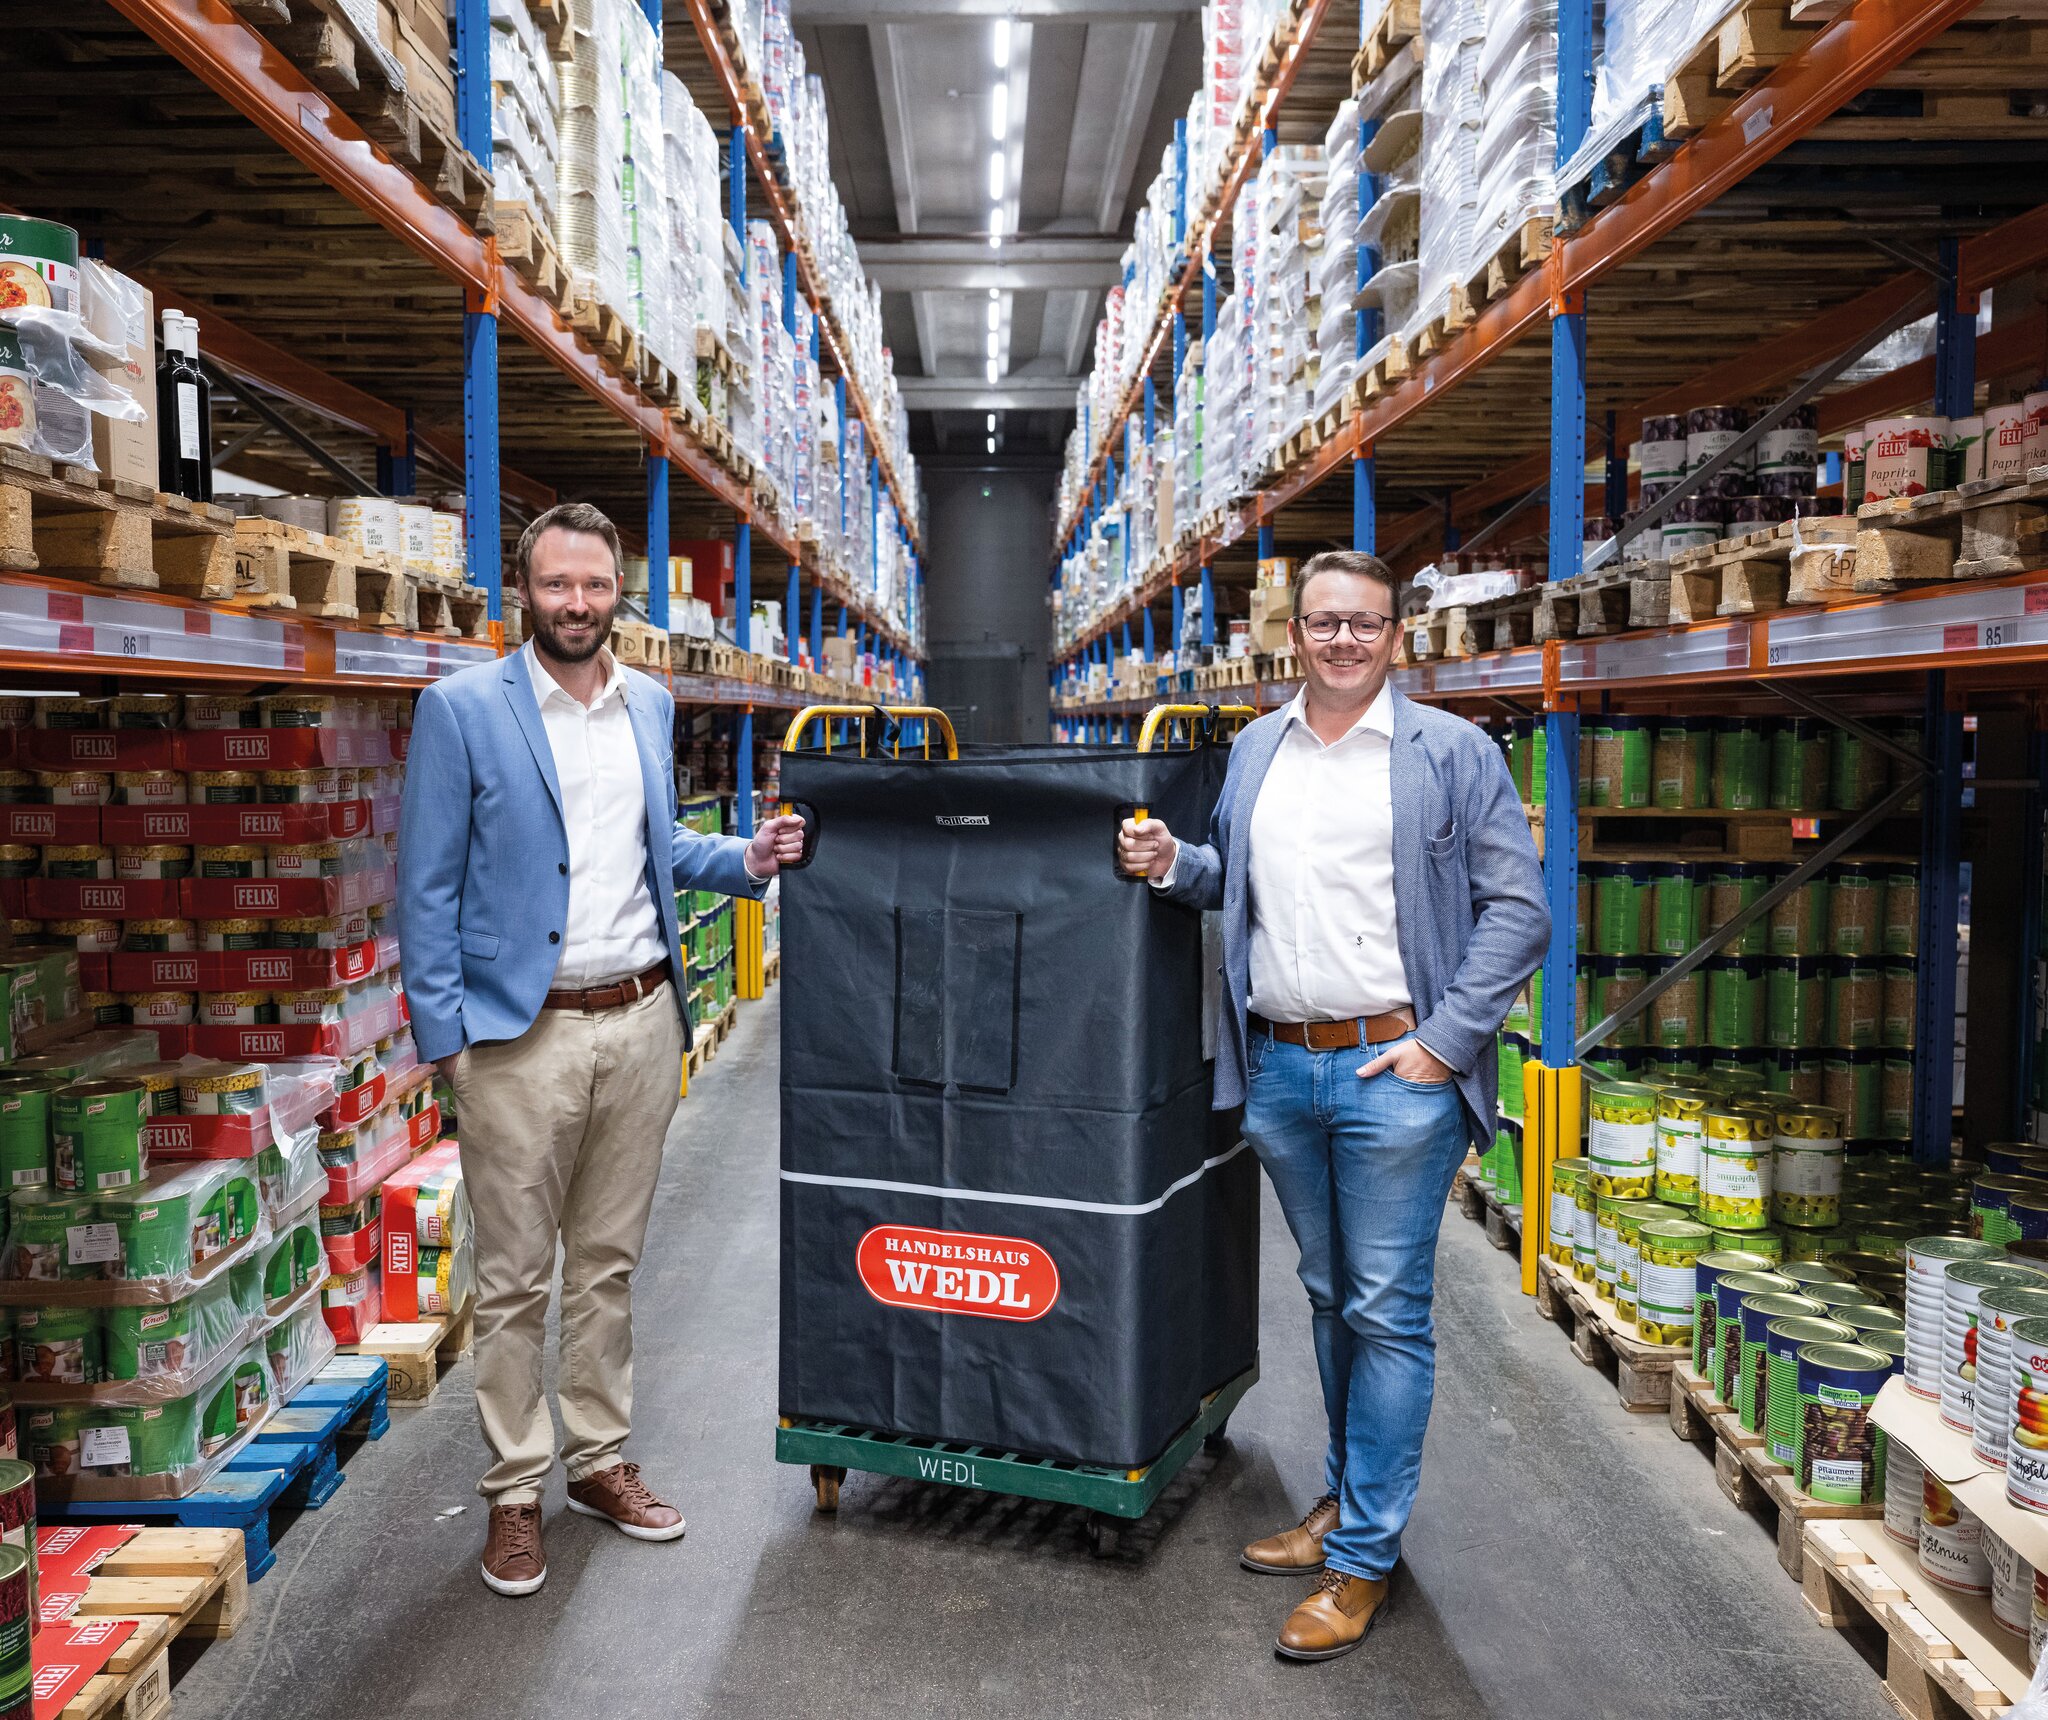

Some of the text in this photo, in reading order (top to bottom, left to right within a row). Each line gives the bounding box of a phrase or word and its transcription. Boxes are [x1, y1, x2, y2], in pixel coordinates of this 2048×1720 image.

[2024, 420, 2039, 436] ELIX
[2001, 430, 2023, 445] FELI
[1878, 442, 1908, 457] FELIX
[1871, 467, 1917, 482] Paprika
[123, 635, 137, 655] 86
[1985, 625, 2002, 649] 85
[1769, 647, 1780, 664] 83
[195, 707, 220, 720] FELIX
[75, 738, 114, 757] FELIX
[228, 738, 267, 758] FELIX
[73, 783, 98, 795] FELIX
[146, 782, 172, 795] FELIX
[15, 815, 52, 833] FELIX
[148, 816, 186, 833] FELIX
[244, 815, 282, 833] FELIX
[937, 816, 987, 825] RolliCoat
[120, 856, 141, 868] FELIX
[277, 855, 302, 867] FELIX
[84, 888, 122, 907] FELIX
[238, 887, 276, 906] FELIX
[156, 962, 195, 981] FELIX
[251, 960, 290, 978] FELIX
[151, 1002, 177, 1016] FELIX
[210, 1002, 236, 1015] FELIX
[295, 1001, 322, 1014] FELIX
[244, 1034, 283, 1053] FELIX
[358, 1089, 373, 1113] FELIX
[419, 1115, 432, 1138] FELIX
[429, 1216, 441, 1239] FELIX
[391, 1235, 409, 1271] FELIX
[884, 1237, 1030, 1267] HANDELSHAUS
[884, 1258, 1031, 1309] WEDL
[141, 1310, 169, 1327] Knorr
[918, 1455, 983, 1487] WEDL
[1817, 1466, 1855, 1477] Pflaumen
[40, 1526, 81, 1553] FELIX
